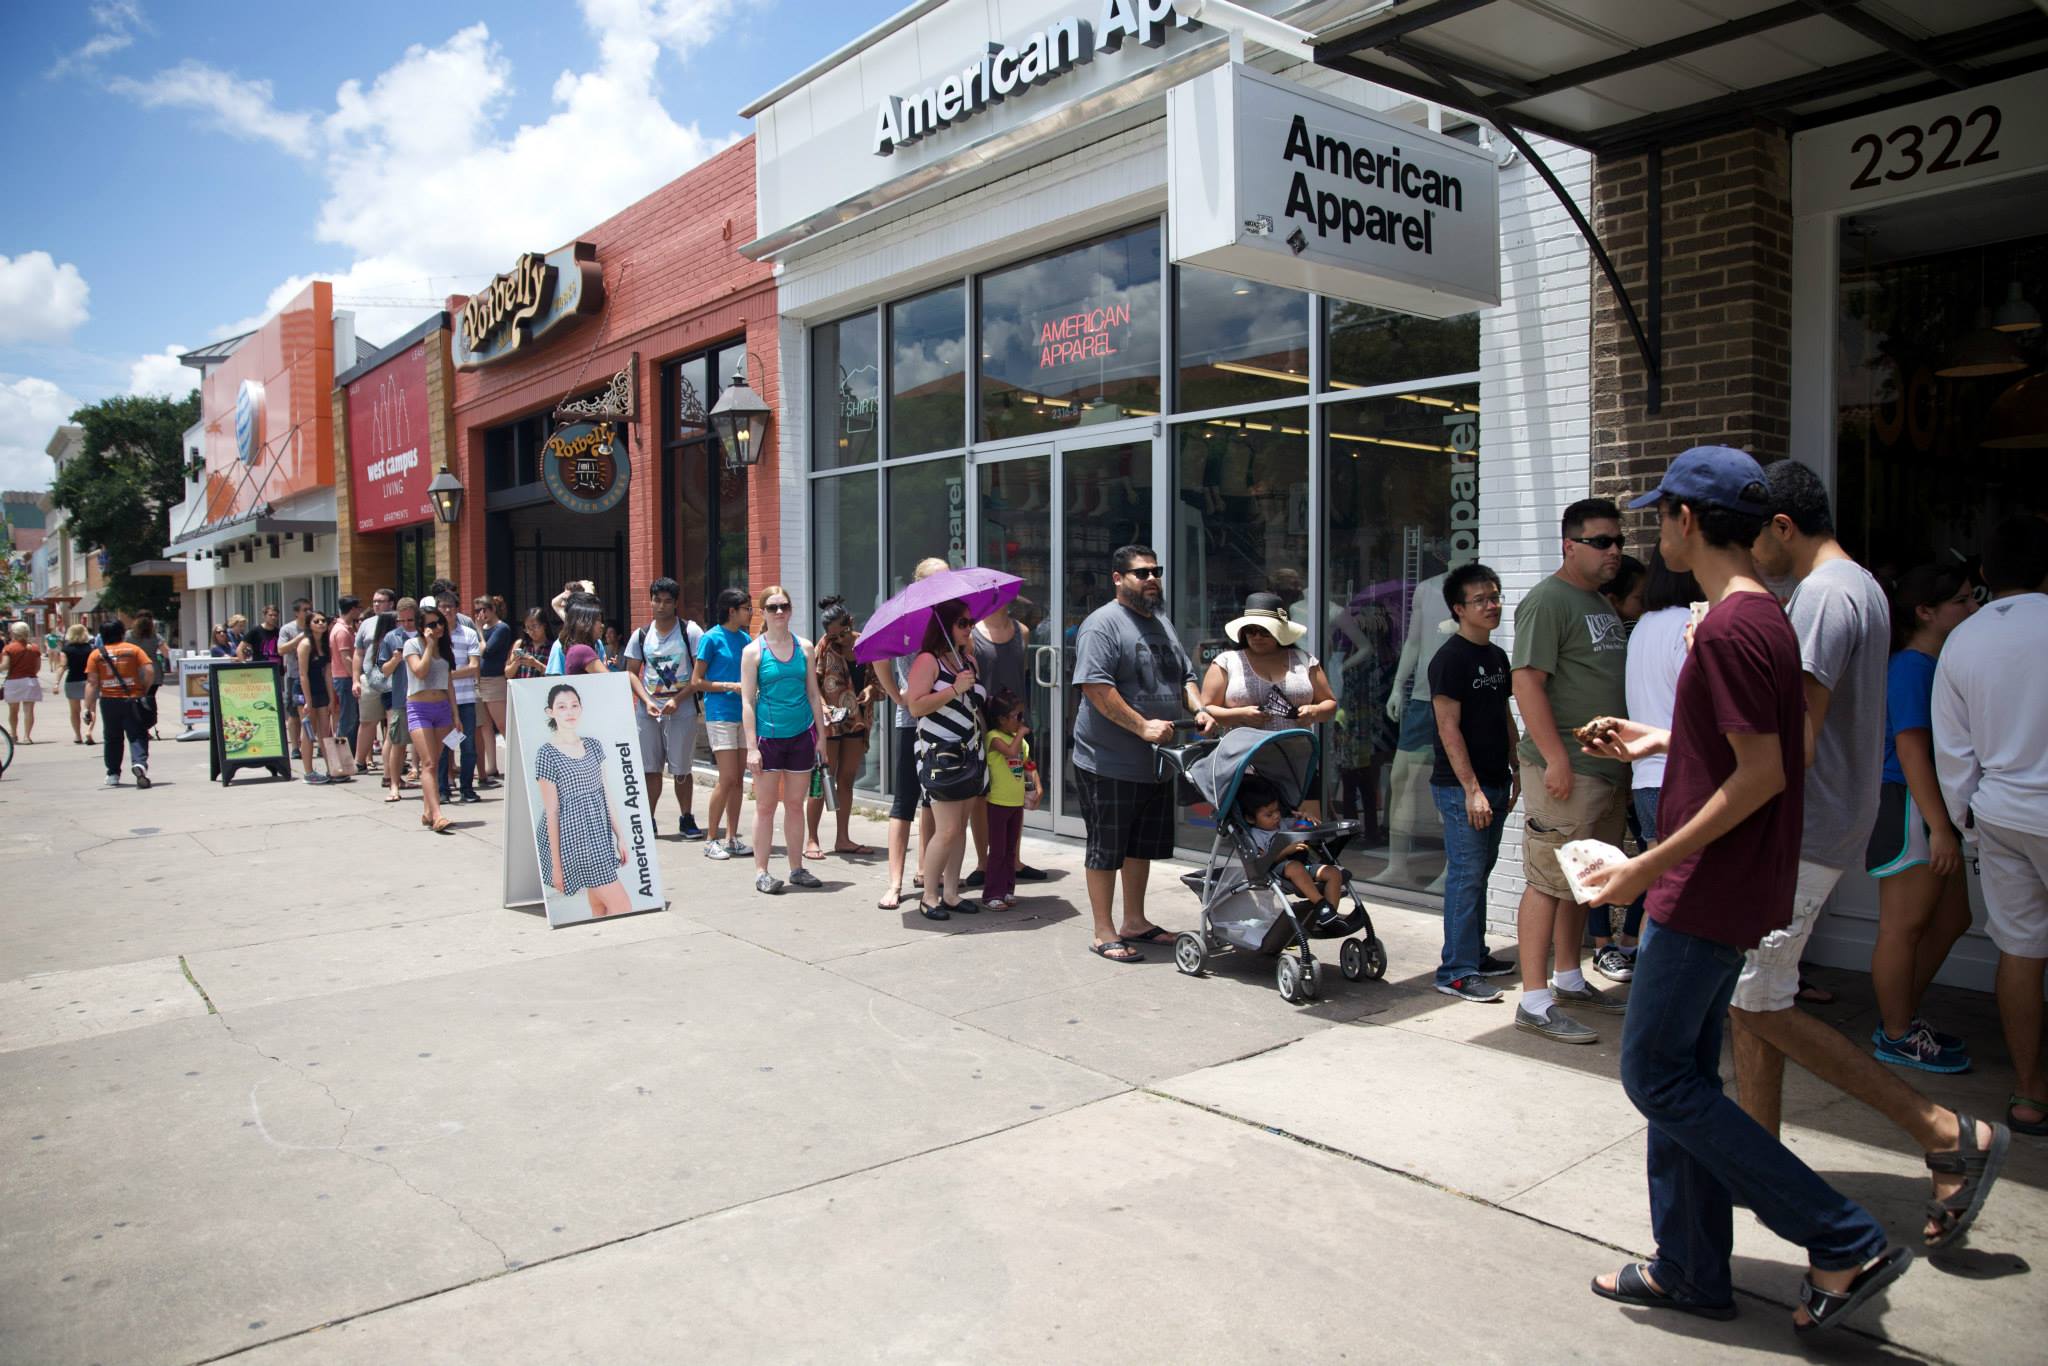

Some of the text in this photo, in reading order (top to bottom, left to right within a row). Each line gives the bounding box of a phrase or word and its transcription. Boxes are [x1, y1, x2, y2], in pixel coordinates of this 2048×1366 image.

[873, 0, 1190, 154] American Ap
[1283, 114, 1462, 212] American
[1850, 105, 2002, 190] 2322
[1285, 171, 1433, 255] Apparel
[464, 253, 546, 351] Potbelly
[1040, 303, 1131, 345] AMERICAN
[1040, 332, 1117, 368] APPAREL
[368, 448, 419, 482] west campus
[550, 425, 616, 457] Potbelly
[383, 479, 404, 498] LIVING
[1442, 412, 1479, 563] pparel
[616, 742, 654, 898] American Apparel
